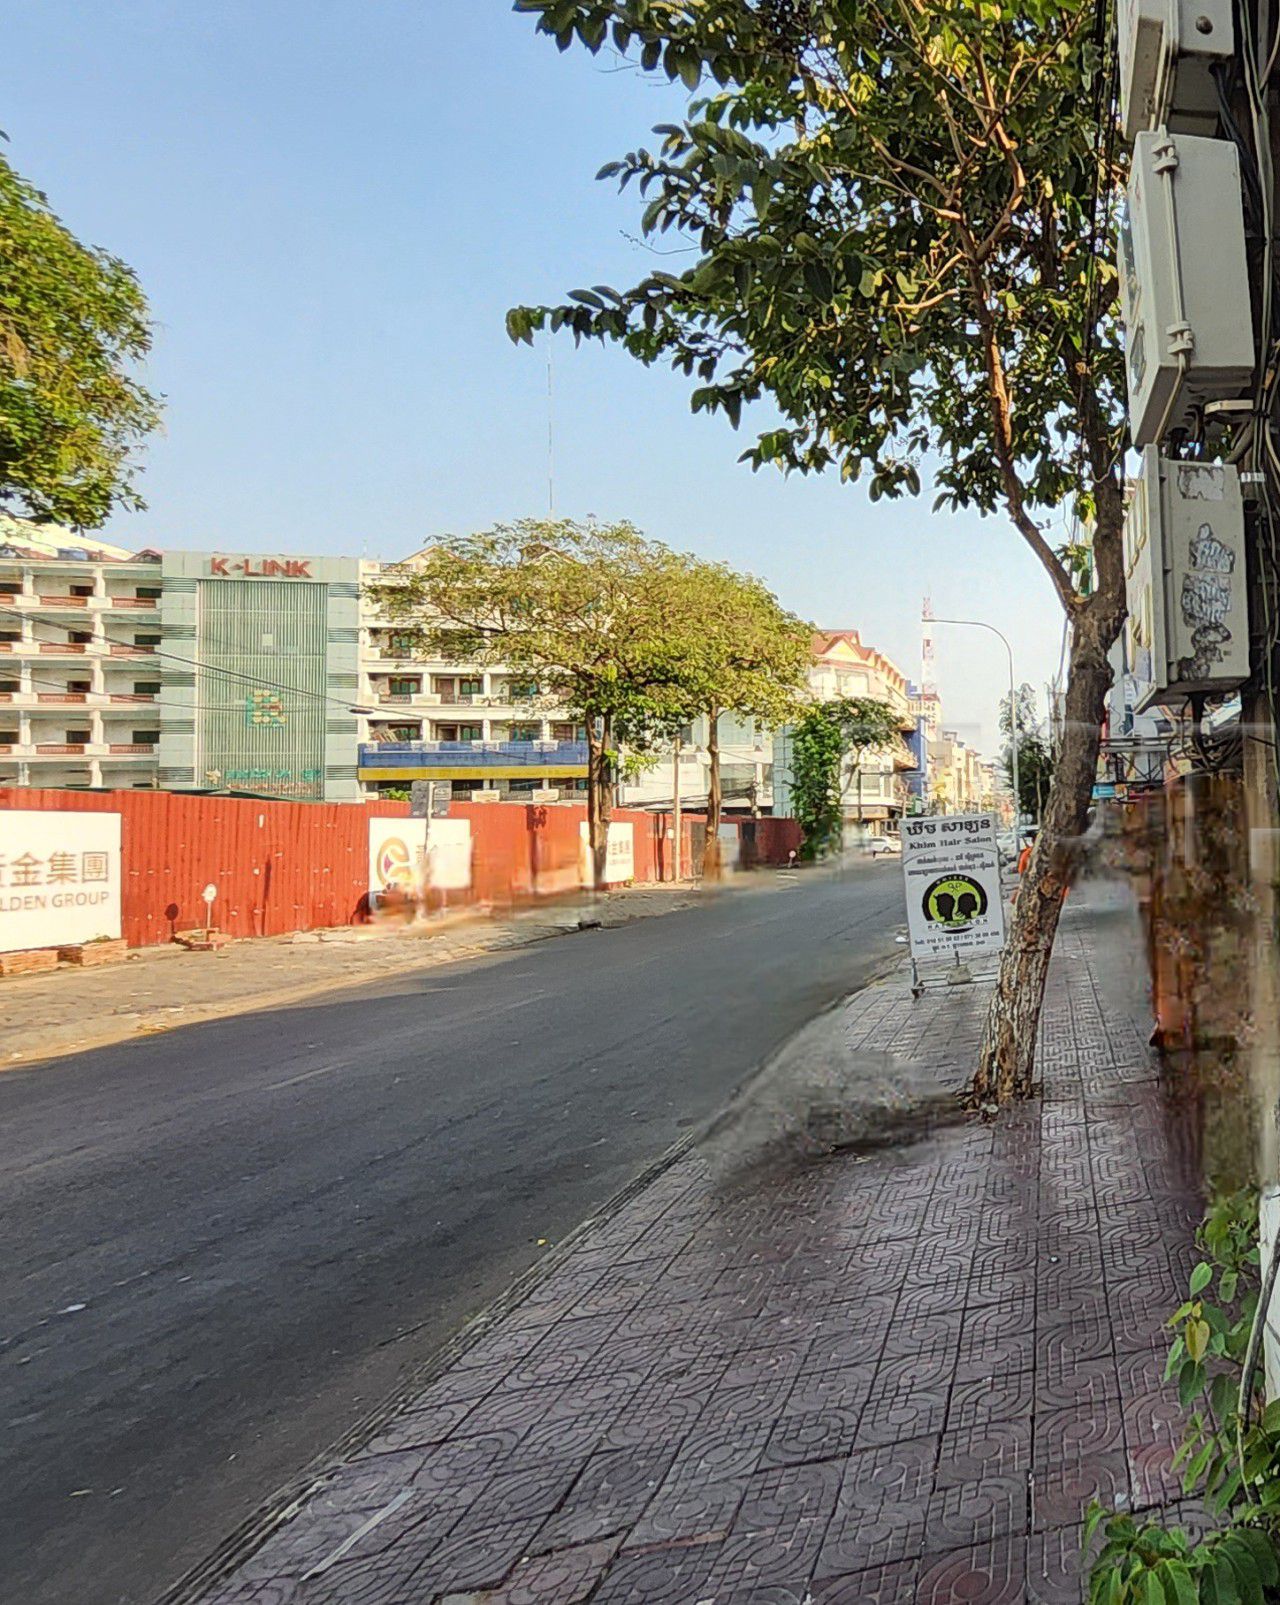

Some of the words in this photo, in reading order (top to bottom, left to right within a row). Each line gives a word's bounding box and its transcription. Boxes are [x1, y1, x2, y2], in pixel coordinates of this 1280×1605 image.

[210, 556, 313, 579] K-LINK
[909, 840, 936, 850] Khim
[939, 837, 962, 848] Hair
[964, 835, 992, 845] Salon
[51, 891, 110, 909] GROUP
